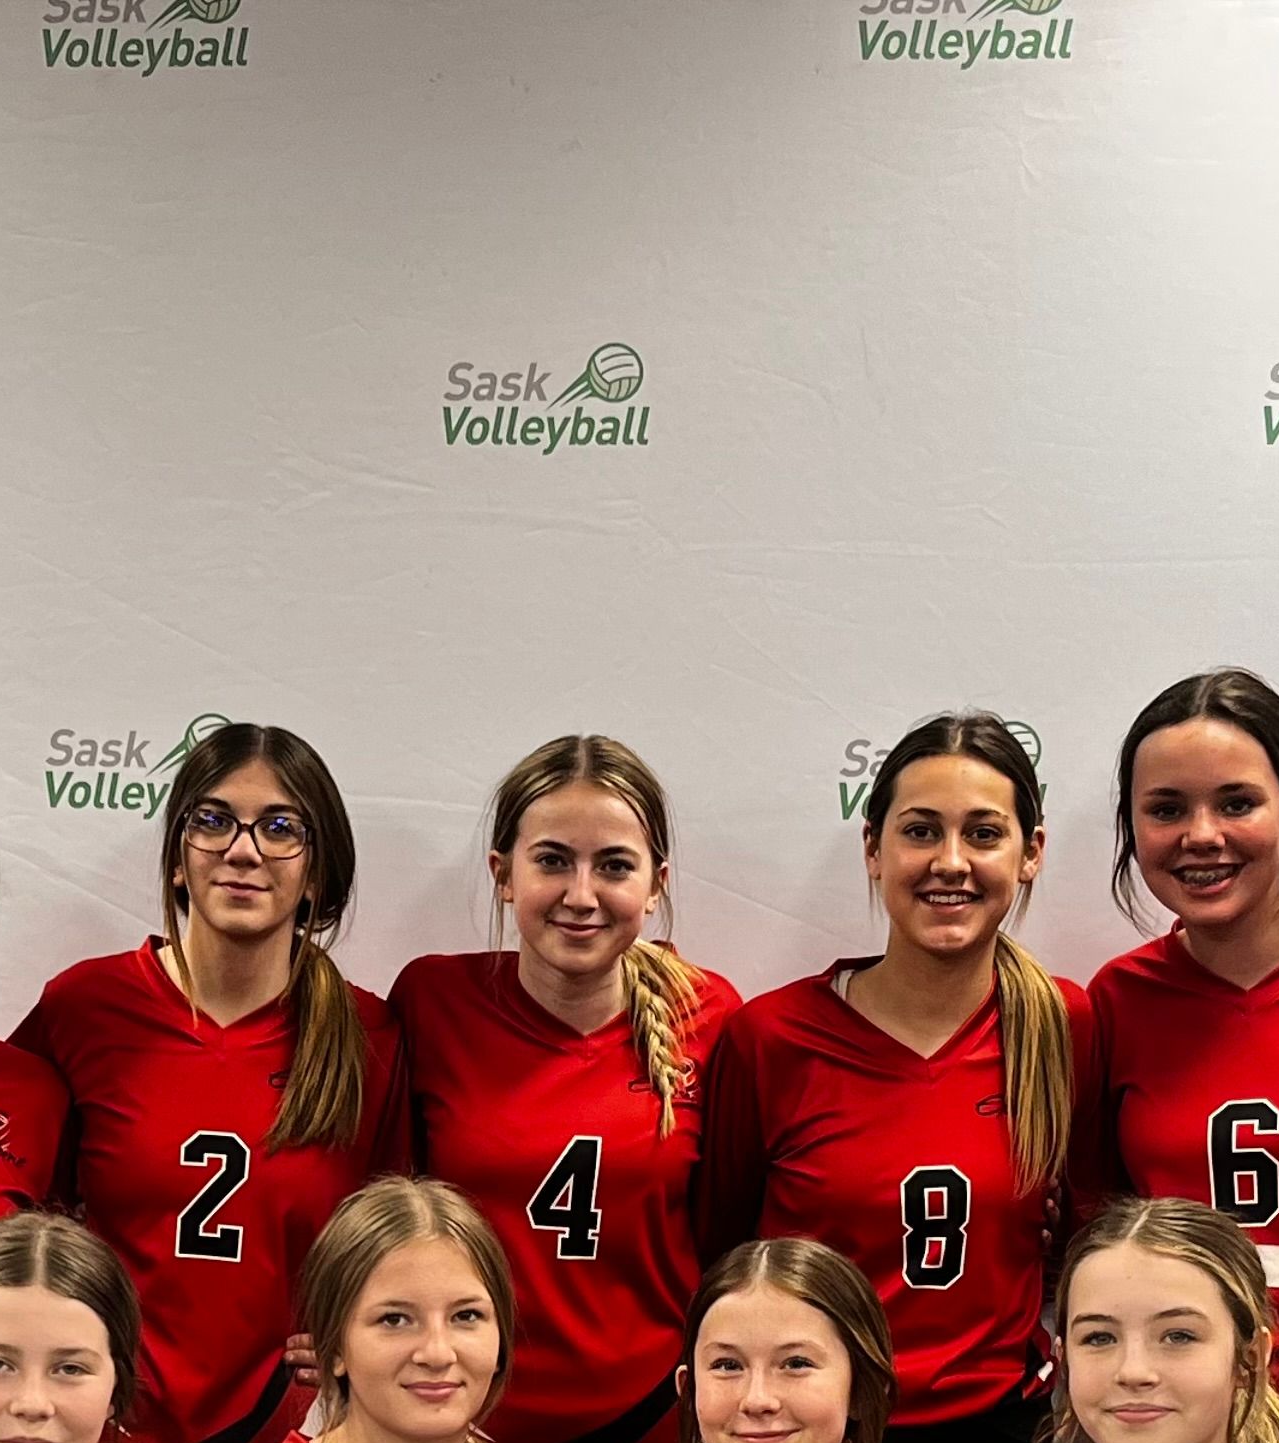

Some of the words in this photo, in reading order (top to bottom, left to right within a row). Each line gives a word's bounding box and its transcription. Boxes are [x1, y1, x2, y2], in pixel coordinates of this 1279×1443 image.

[42, 27, 249, 78] Volleyball
[858, 18, 1074, 70] Volleyball
[443, 361, 552, 402] Sask
[442, 406, 650, 456] Volleyball
[45, 728, 150, 768] Sask
[45, 770, 171, 820] Volley
[175, 1130, 250, 1262] 2
[526, 1135, 603, 1261] 4
[900, 1164, 971, 1290] 8
